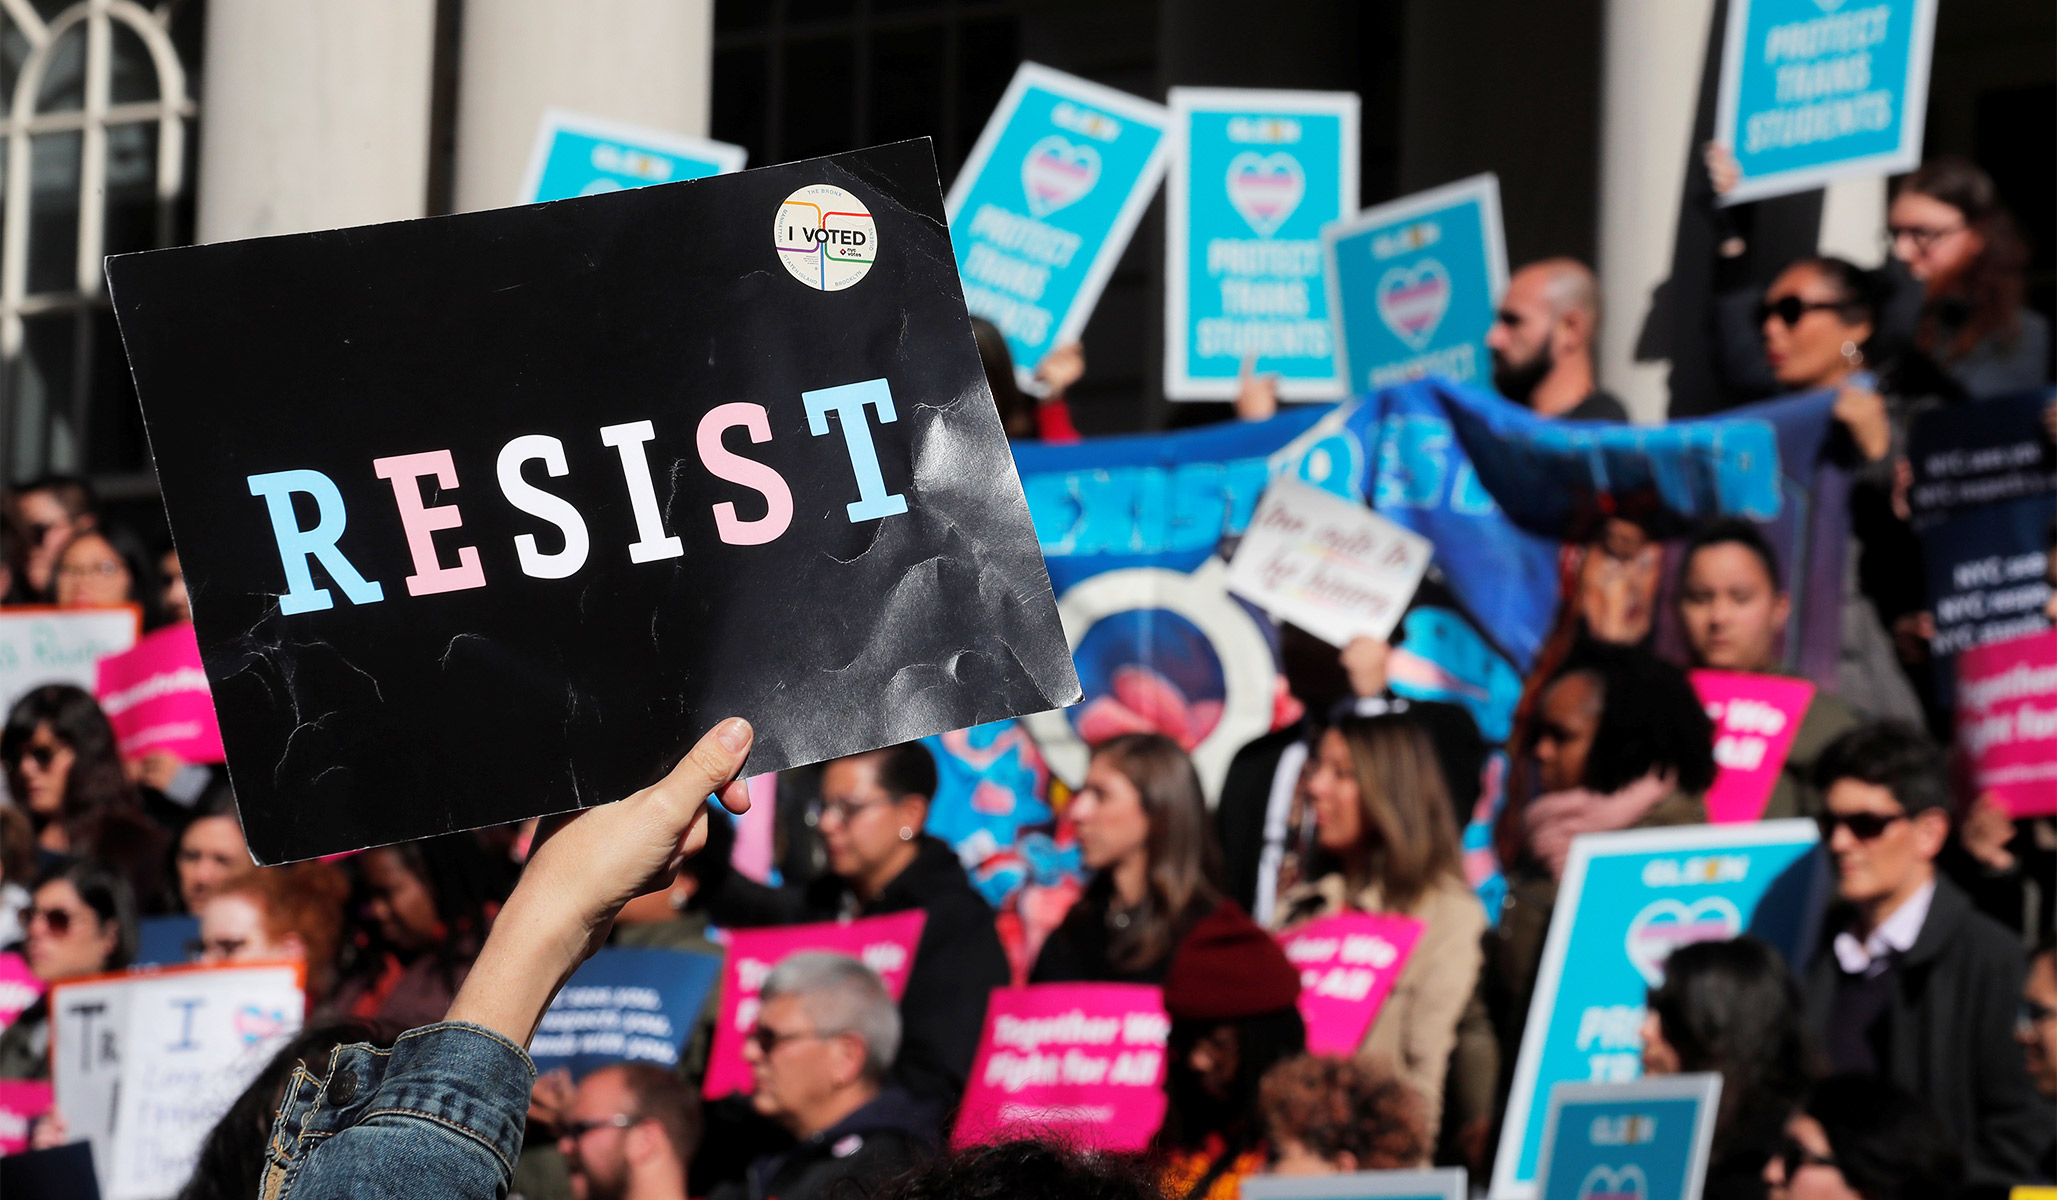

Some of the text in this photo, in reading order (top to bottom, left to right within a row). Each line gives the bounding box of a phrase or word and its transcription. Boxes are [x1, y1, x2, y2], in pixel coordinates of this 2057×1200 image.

[1765, 4, 1890, 64] PROTECT
[1775, 50, 1872, 103] TRANS
[1745, 88, 1892, 154] STUDENTS
[807, 188, 842, 198] THE BRONX
[778, 208, 788, 243] MANHATTAN
[788, 226, 866, 246] I VOTED
[783, 254, 799, 275] STATEN
[799, 271, 818, 285] ISLAND
[1206, 238, 1322, 277] PROTECT
[834, 270, 862, 287] BROOKLYN
[1220, 276, 1310, 317] TRANS
[1195, 316, 1332, 358] STUDENTS
[247, 377, 908, 617] RESIST
[994, 1010, 1119, 1053] Together
[983, 1048, 1161, 1094] Fight for All
